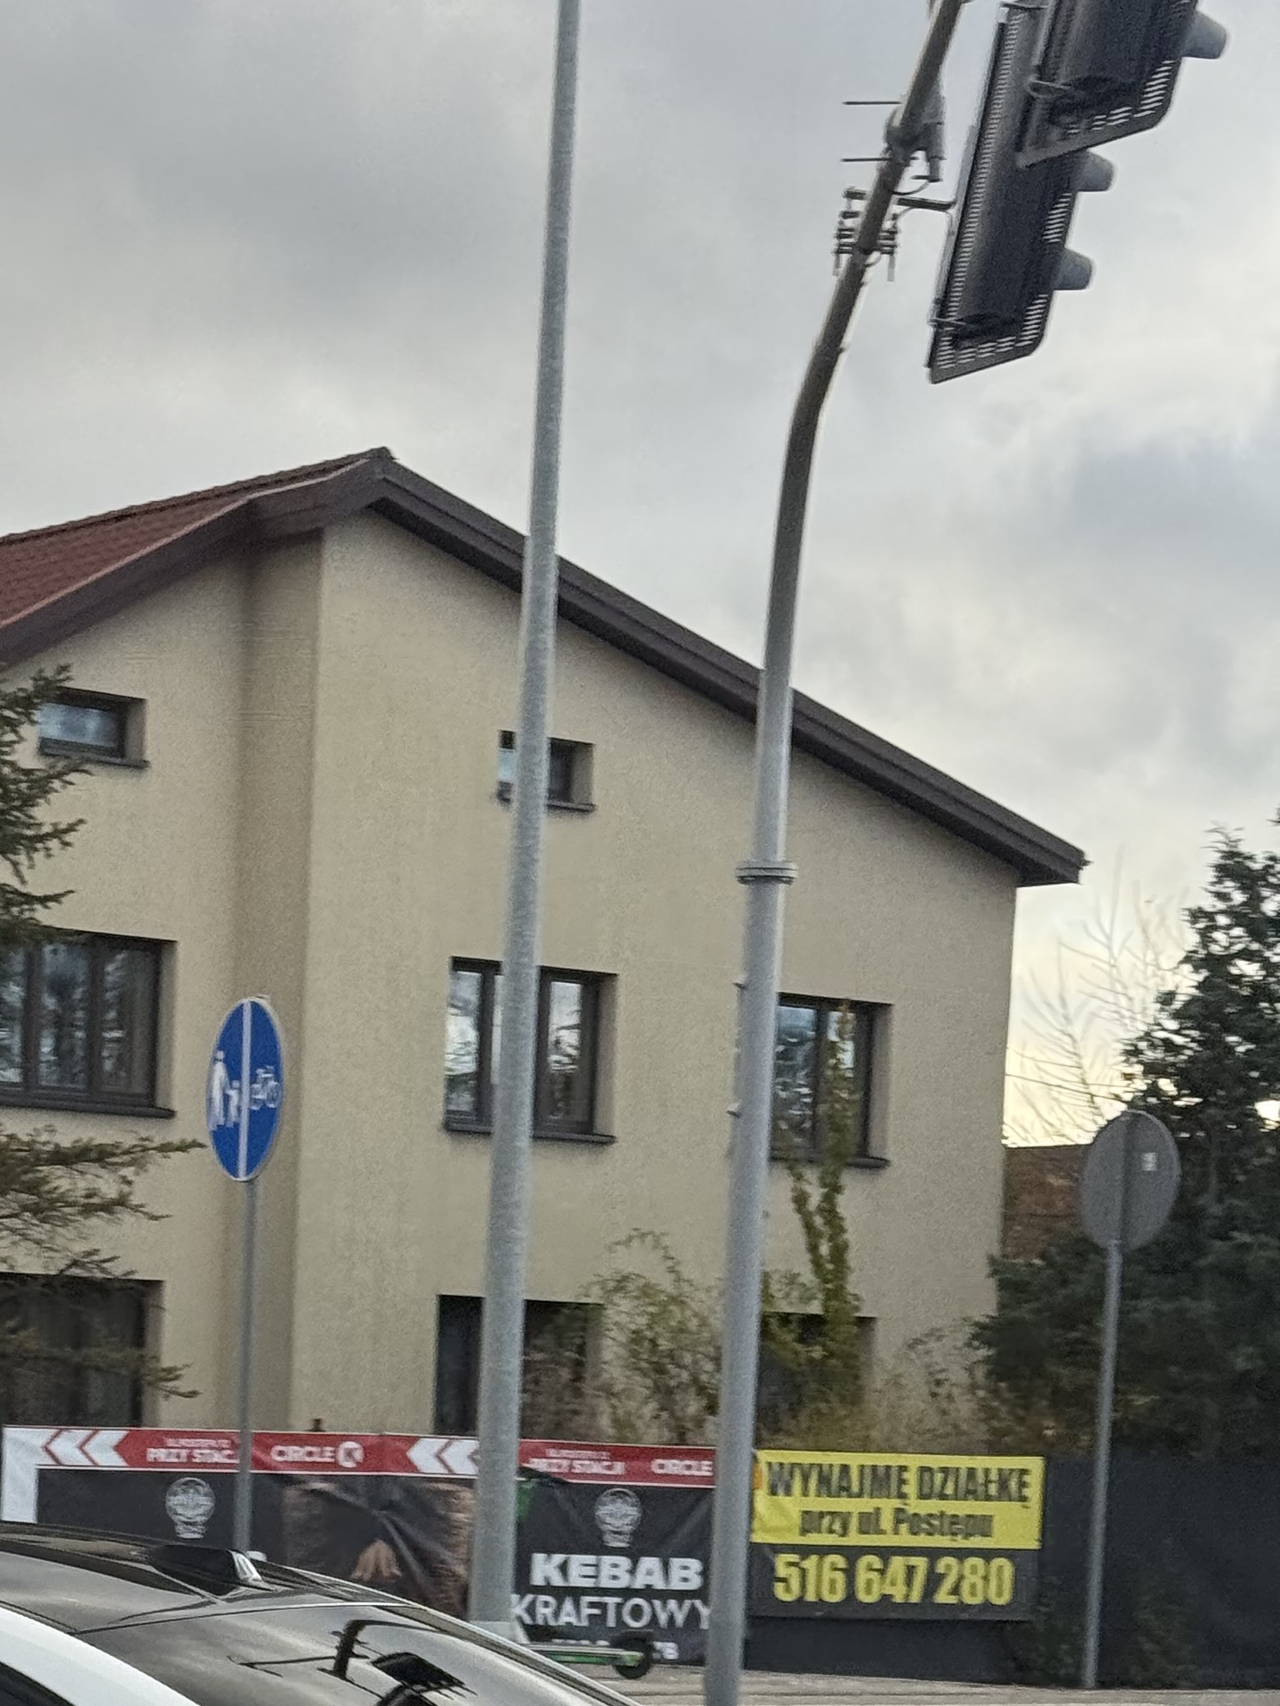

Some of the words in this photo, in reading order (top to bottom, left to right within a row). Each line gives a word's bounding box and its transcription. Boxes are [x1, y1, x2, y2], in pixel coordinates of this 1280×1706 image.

[270, 1445, 335, 1463] CIRCLE
[651, 1458, 714, 1477] CIRCLE
[800, 1509, 851, 1538] przy
[529, 1553, 704, 1590] KEBAB
[773, 1553, 848, 1603] 516
[855, 1554, 928, 1604] 647
[934, 1556, 1015, 1606] 280
[511, 1593, 710, 1630] KRAFTOWY
